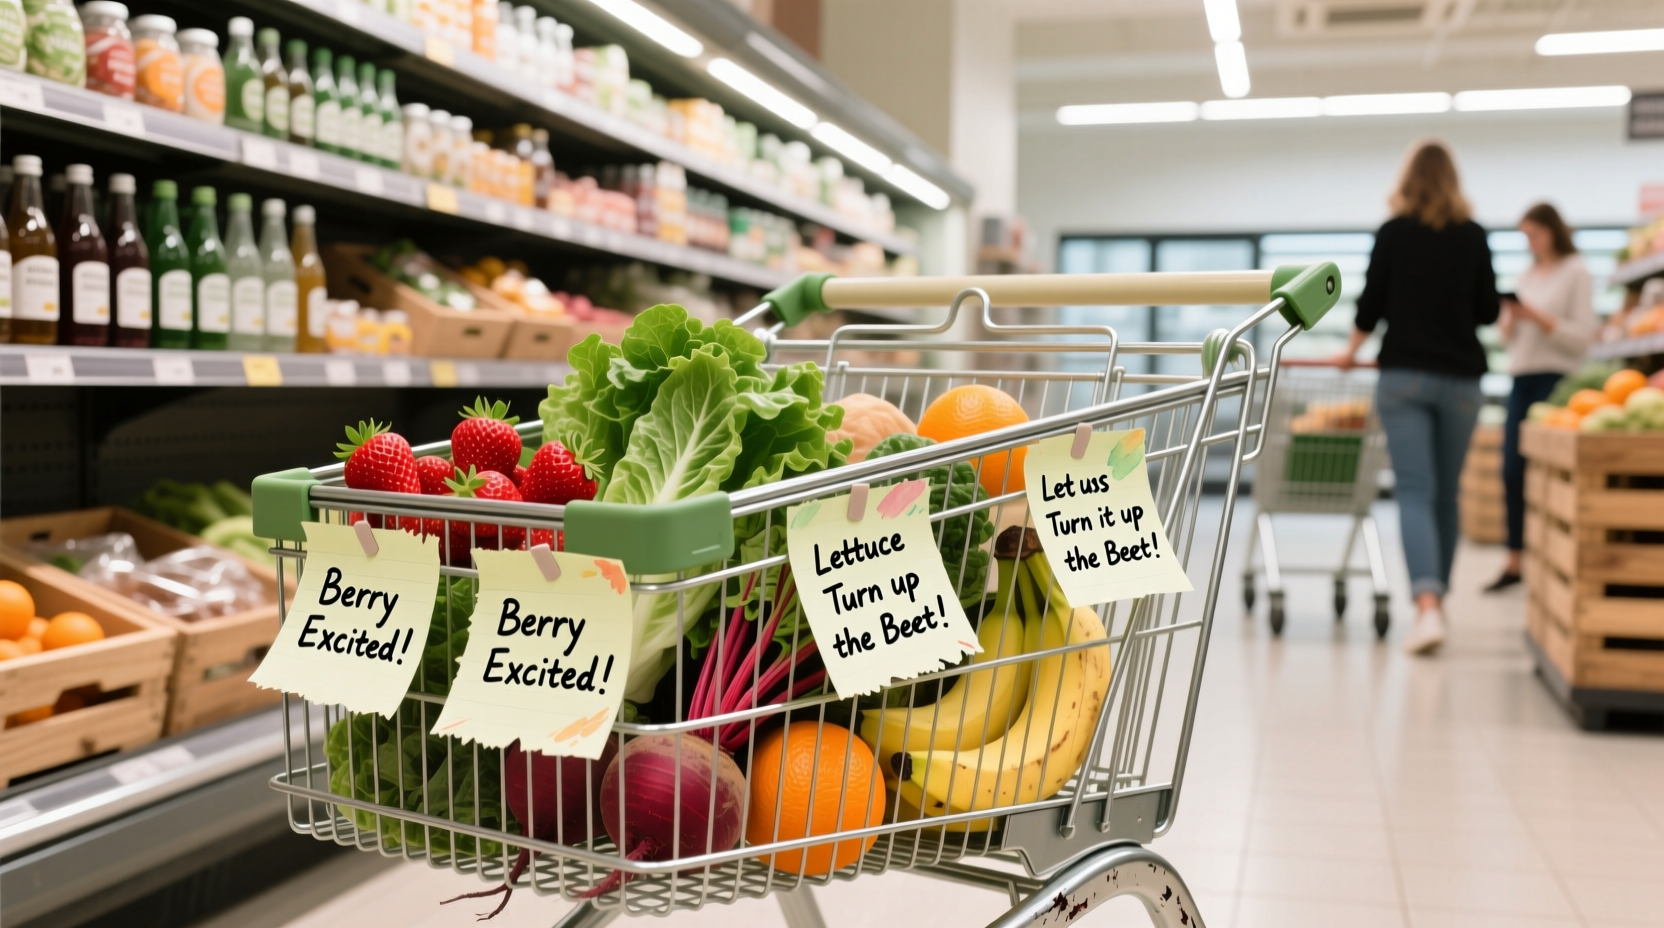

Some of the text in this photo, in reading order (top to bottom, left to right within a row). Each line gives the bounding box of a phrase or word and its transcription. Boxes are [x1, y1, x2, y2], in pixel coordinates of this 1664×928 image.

[1041, 473, 1076, 502] Let
[1046, 506, 1144, 537] Turn it up
[814, 533, 906, 577] Lettuce
[1064, 532, 1160, 572] the Beet!
[318, 566, 399, 629] Berry
[822, 572, 920, 615] Turn up
[298, 614, 414, 665] Excited!
[497, 597, 586, 657] Berry
[833, 594, 949, 659] the Beet!
[482, 647, 615, 696] Excited!
